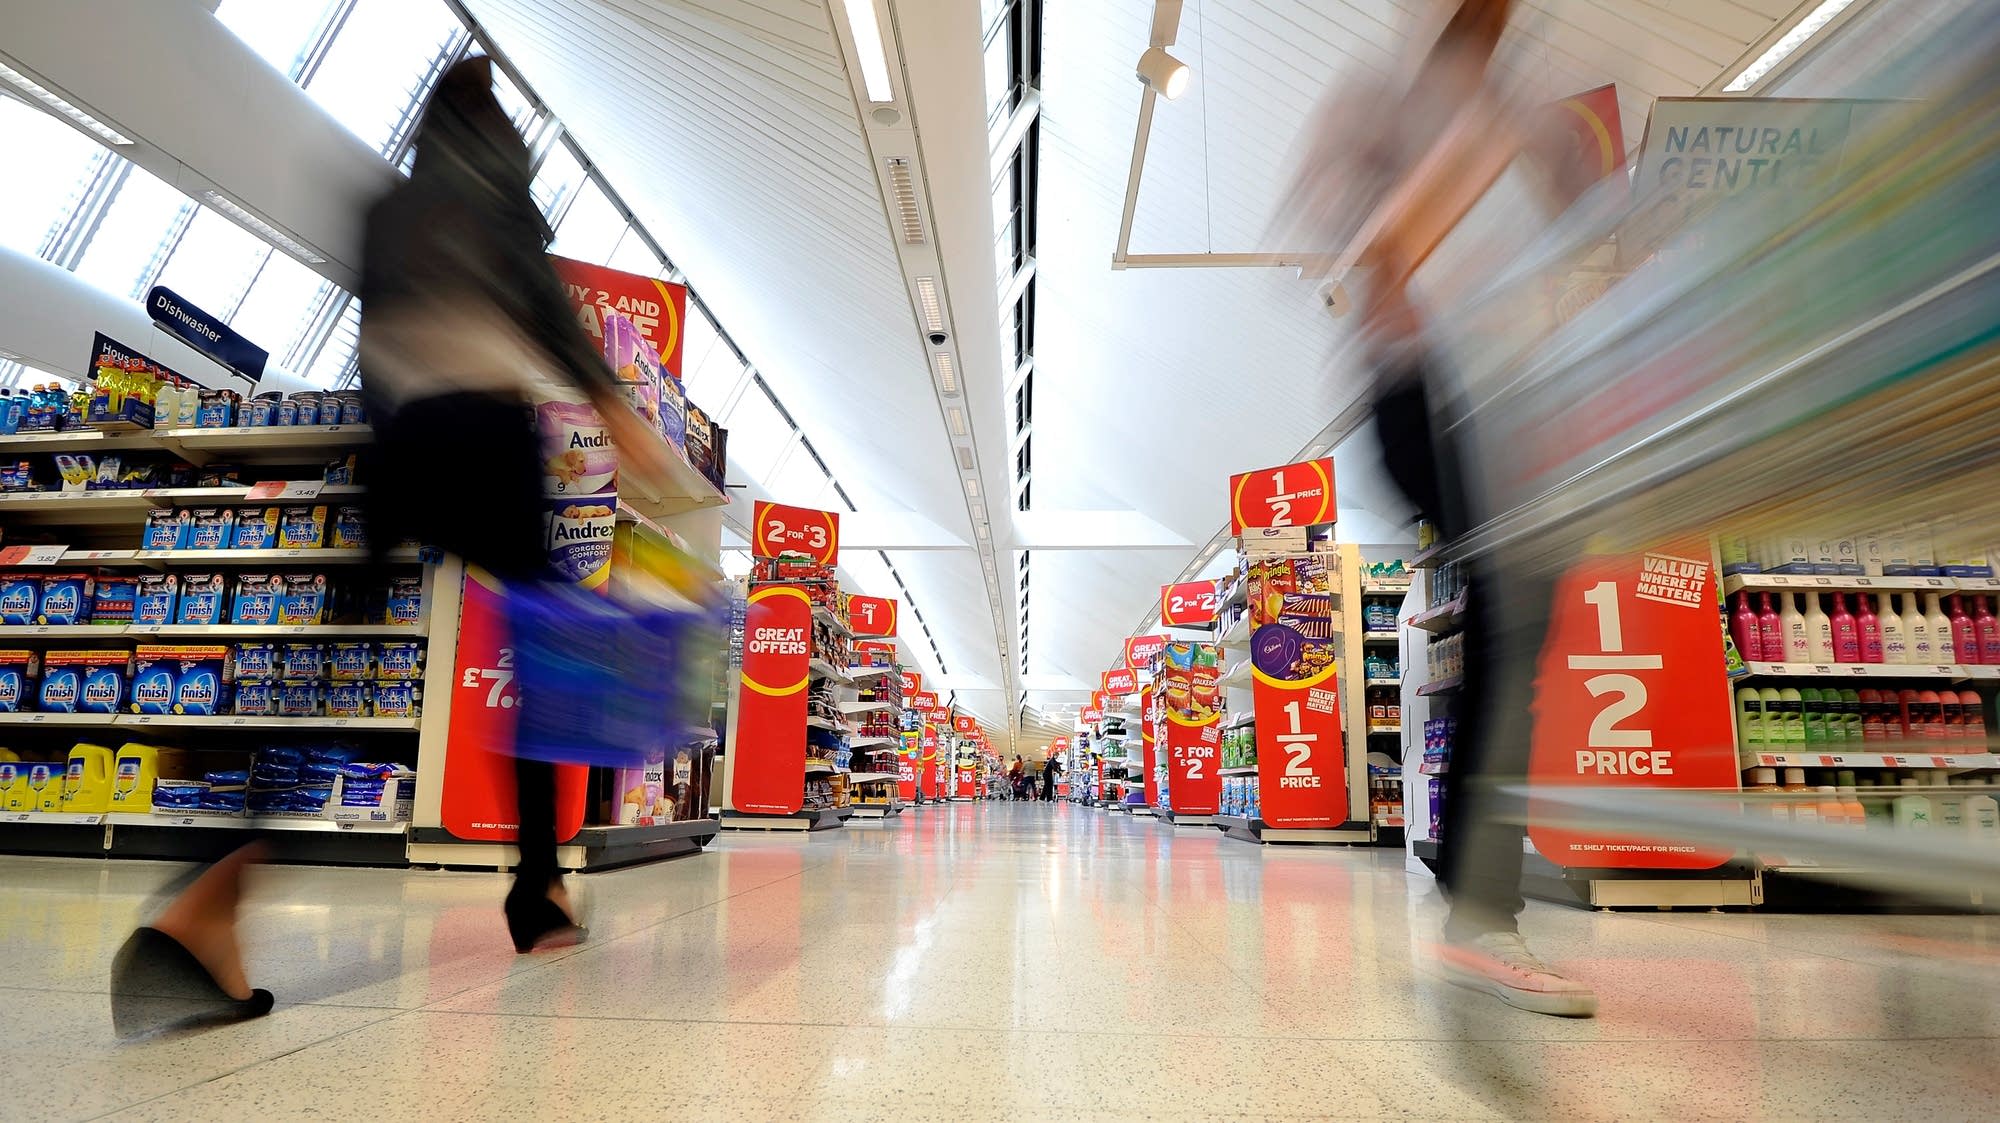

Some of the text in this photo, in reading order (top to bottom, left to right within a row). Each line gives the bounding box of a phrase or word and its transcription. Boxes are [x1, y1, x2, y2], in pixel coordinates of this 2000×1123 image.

[1664, 126, 1825, 155] NATURAL
[1659, 157, 1818, 190] GENTL
[560, 283, 660, 317] UY 2 AND
[156, 295, 222, 343] Dishwasher
[573, 303, 659, 350] AE
[102, 342, 131, 364] Hous
[635, 352, 657, 386] Andrex
[688, 419, 709, 442] Andrex
[569, 431, 617, 449] Andr
[557, 482, 566, 492] 9
[1271, 471, 1285, 495] 1
[1271, 488, 1322, 527] 2 PRICE
[151, 529, 177, 543] finish
[195, 529, 220, 543] finish
[239, 529, 264, 543] finish
[287, 529, 312, 543] finish
[343, 529, 367, 542] finis
[555, 521, 614, 541] Andrex
[767, 520, 827, 549] 2 FOR £3
[569, 544, 610, 554] GORGEOUS
[572, 550, 608, 559] COMFORT
[1263, 565, 1291, 580] Pringles
[1644, 557, 1708, 581] VALUE
[1640, 572, 1705, 591] WHERE IT
[1637, 582, 1702, 603] MATTERS
[2, 596, 30, 610] finish
[45, 596, 74, 610] finish
[861, 602, 878, 610] ONLY
[1170, 596, 1184, 613] 2
[141, 604, 167, 618] finish
[186, 604, 212, 618] finish
[241, 604, 270, 618] finish
[287, 604, 315, 617] finish
[1584, 581, 1623, 652] 1
[755, 627, 804, 642] GREAT
[749, 640, 807, 655] OFFERS
[1134, 643, 1162, 652] GREAT
[240, 657, 268, 670] finish
[290, 658, 318, 671] finish
[336, 658, 364, 670] finish
[383, 657, 411, 670] finish
[497, 648, 514, 668] 2
[1108, 681, 1133, 689] OFFERS
[1109, 675, 1131, 683] GREAT
[45, 685, 74, 698] finish
[86, 685, 115, 698] finish
[137, 684, 169, 698] finish
[181, 684, 212, 699] finish
[462, 668, 522, 709] £7.
[1310, 690, 1336, 700] VALUE
[240, 695, 266, 707] finish
[284, 696, 311, 707] finish
[331, 696, 358, 708] finish
[379, 696, 407, 708] finish
[1283, 701, 1301, 734] 1
[1583, 673, 1653, 748] 2
[1174, 746, 1214, 758] 2 FOR
[1283, 742, 1313, 776] 2
[1180, 758, 1204, 780] £2
[1575, 751, 1673, 775] PRICE
[1280, 777, 1321, 788] PRICE
[1606, 844, 1652, 852] TICKET/PACK
